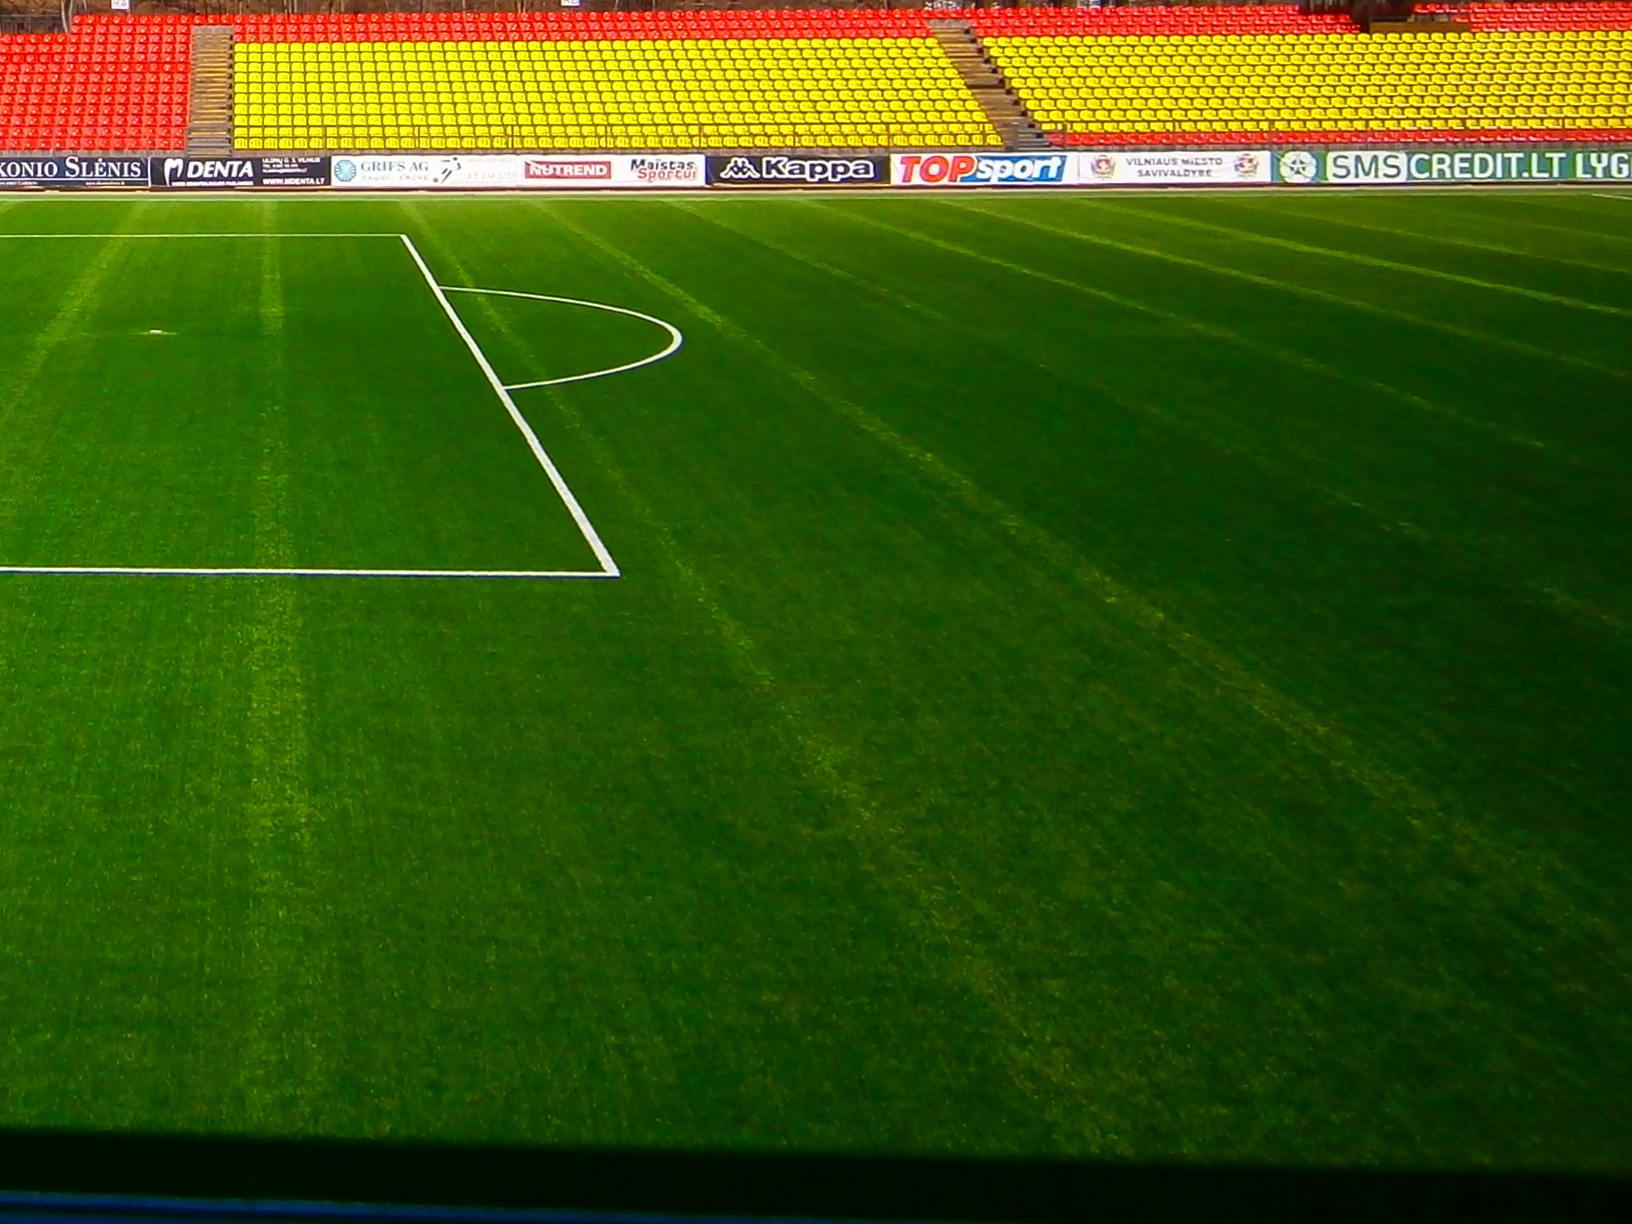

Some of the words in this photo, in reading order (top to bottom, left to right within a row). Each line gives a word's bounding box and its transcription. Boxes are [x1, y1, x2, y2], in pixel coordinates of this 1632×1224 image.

[65, 156, 142, 177] SLĖNIS
[361, 161, 405, 172] GRIFS
[409, 161, 429, 172] AG
[529, 163, 608, 177] NUTREND
[630, 159, 696, 171] Maistas
[762, 157, 875, 182] Kappa
[637, 167, 697, 182] Sportui
